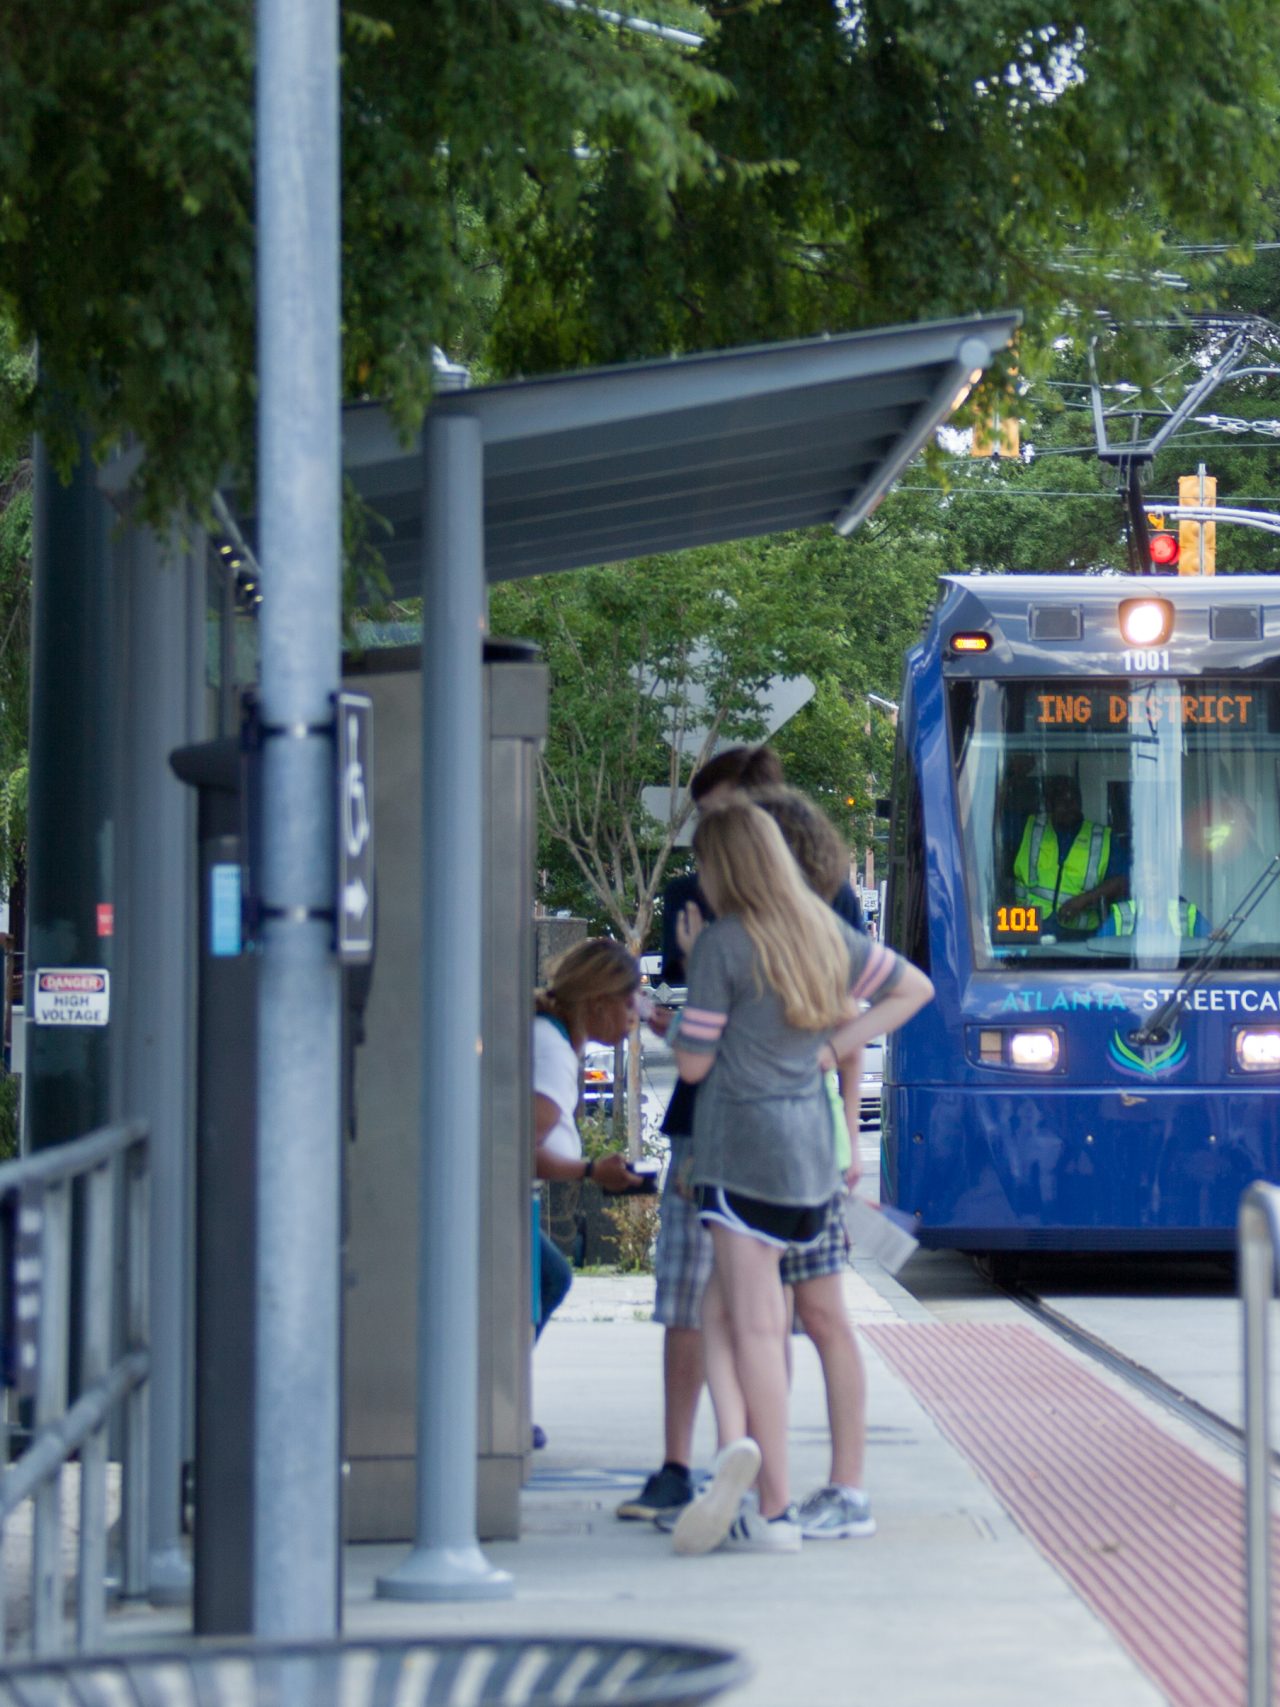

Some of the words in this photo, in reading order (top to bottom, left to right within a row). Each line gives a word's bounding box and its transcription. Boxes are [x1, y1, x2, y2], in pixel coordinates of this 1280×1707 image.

[1122, 650, 1170, 671] 1001
[1037, 695, 1092, 723] ING
[1108, 695, 1253, 723] DISTRICT
[997, 907, 1039, 931] 101
[47, 976, 98, 990] DANGER
[54, 996, 89, 1006] HIGH
[1000, 991, 1126, 1011] ATLANTA
[42, 1010, 101, 1021] VOLTAGE
